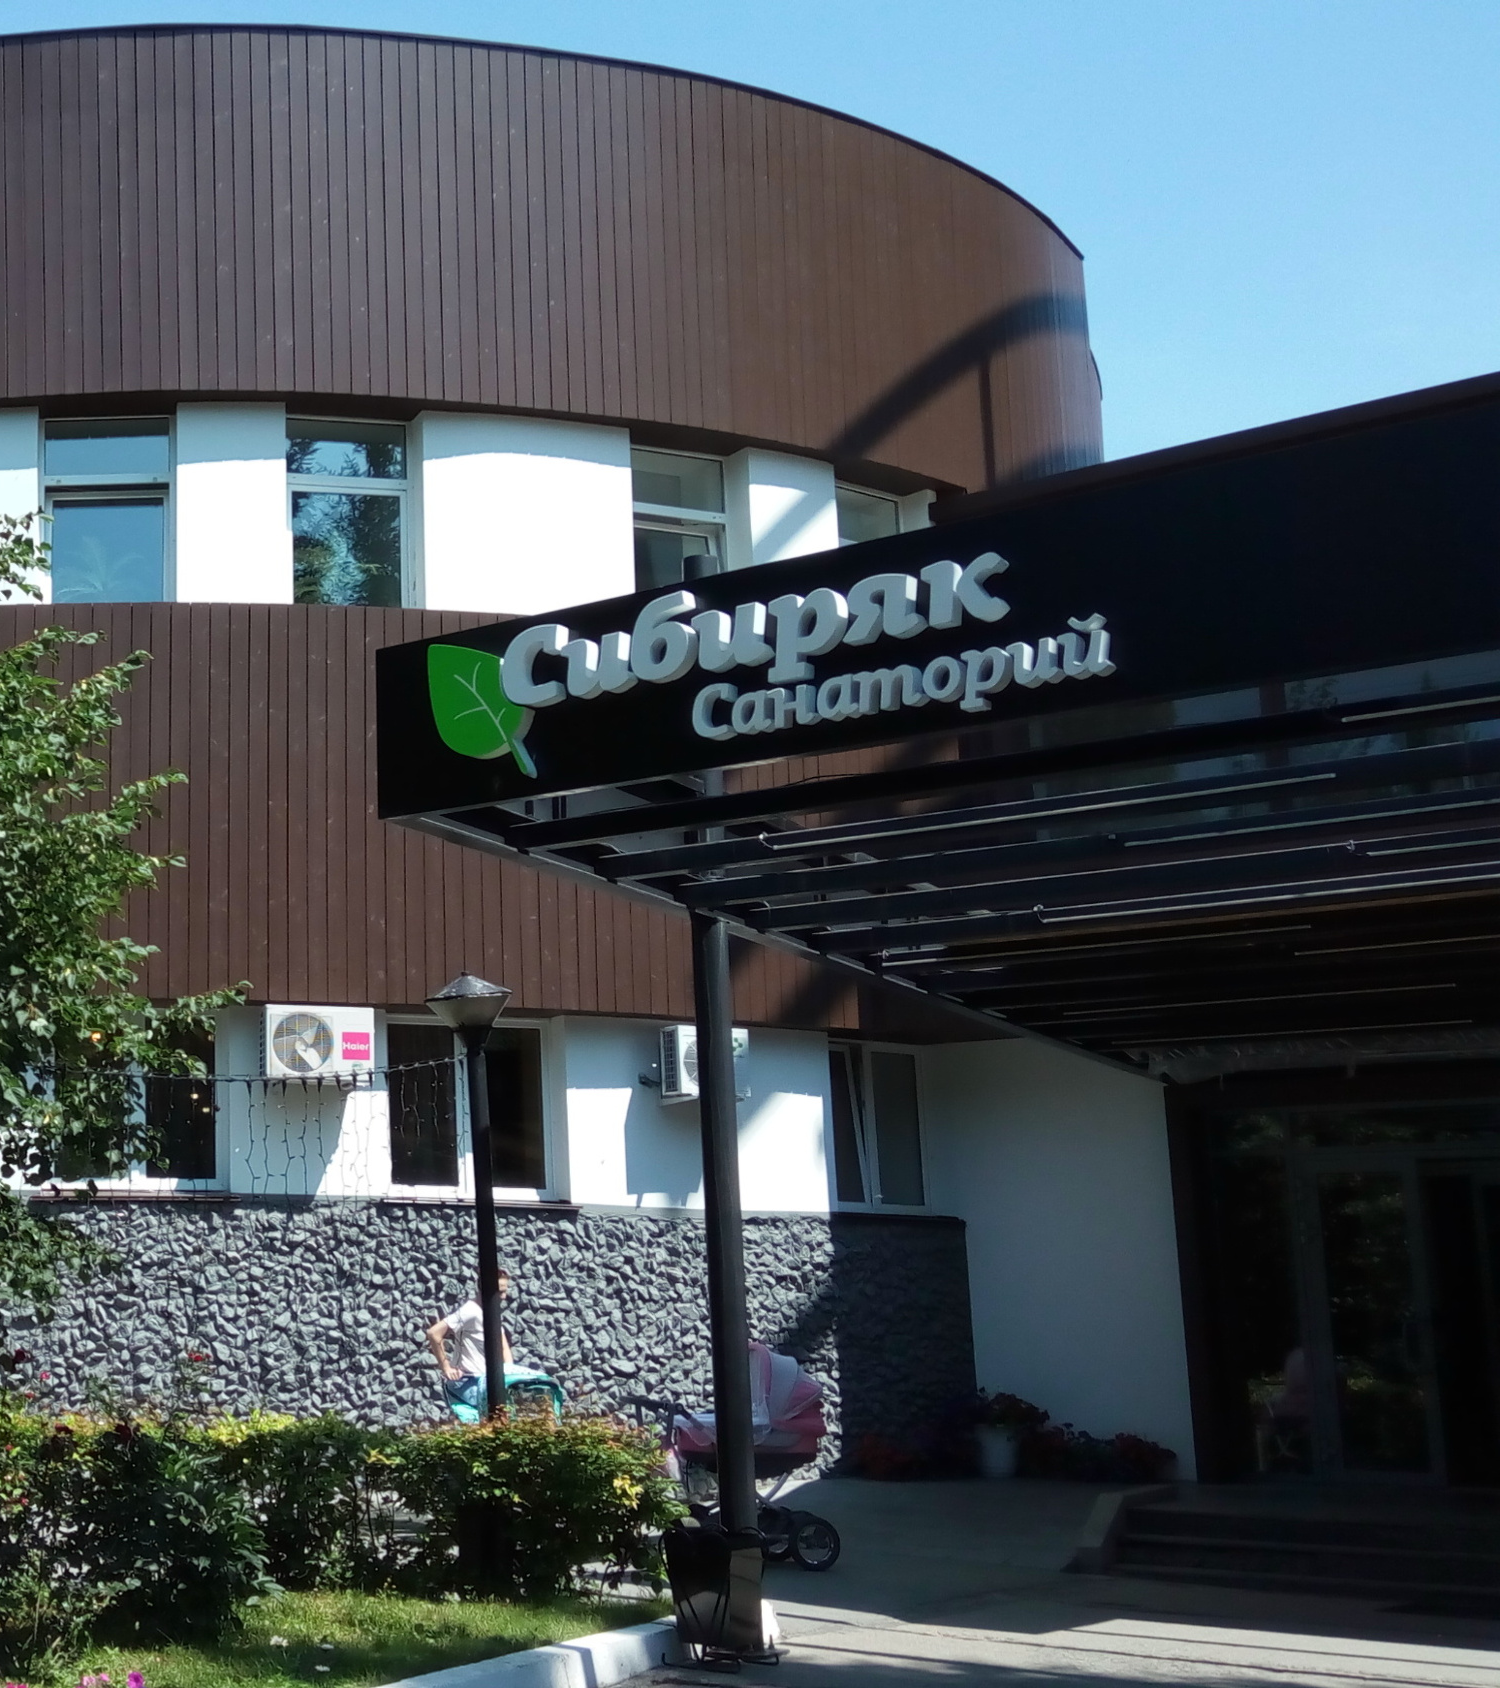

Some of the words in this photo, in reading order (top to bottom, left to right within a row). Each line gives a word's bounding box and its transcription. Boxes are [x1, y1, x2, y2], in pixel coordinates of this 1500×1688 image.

[500, 551, 1012, 708] Сибиряк
[692, 613, 1116, 741] Санаторий
[342, 1041, 370, 1051] Haier
